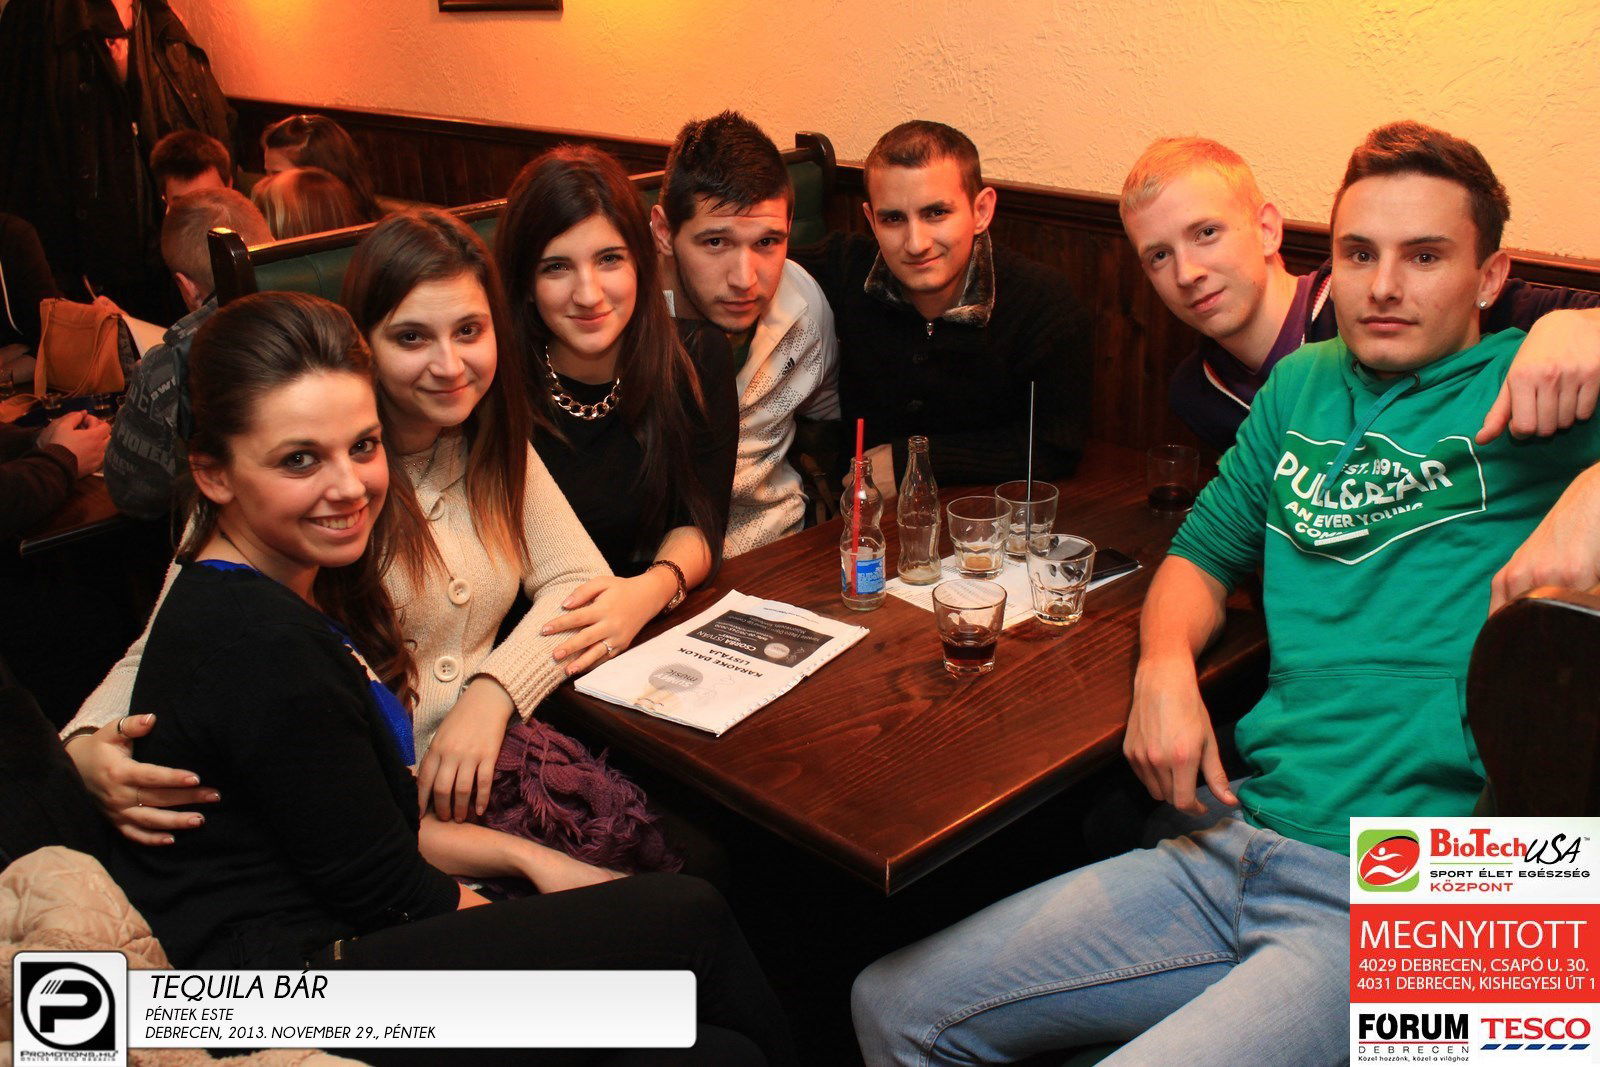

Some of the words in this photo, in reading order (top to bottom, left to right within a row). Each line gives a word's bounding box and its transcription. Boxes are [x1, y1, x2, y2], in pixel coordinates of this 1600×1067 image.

[1284, 500, 1314, 522] AN
[1312, 513, 1356, 529] EVER
[677, 647, 713, 662] DALOK
[713, 658, 764, 679] KARAOKE
